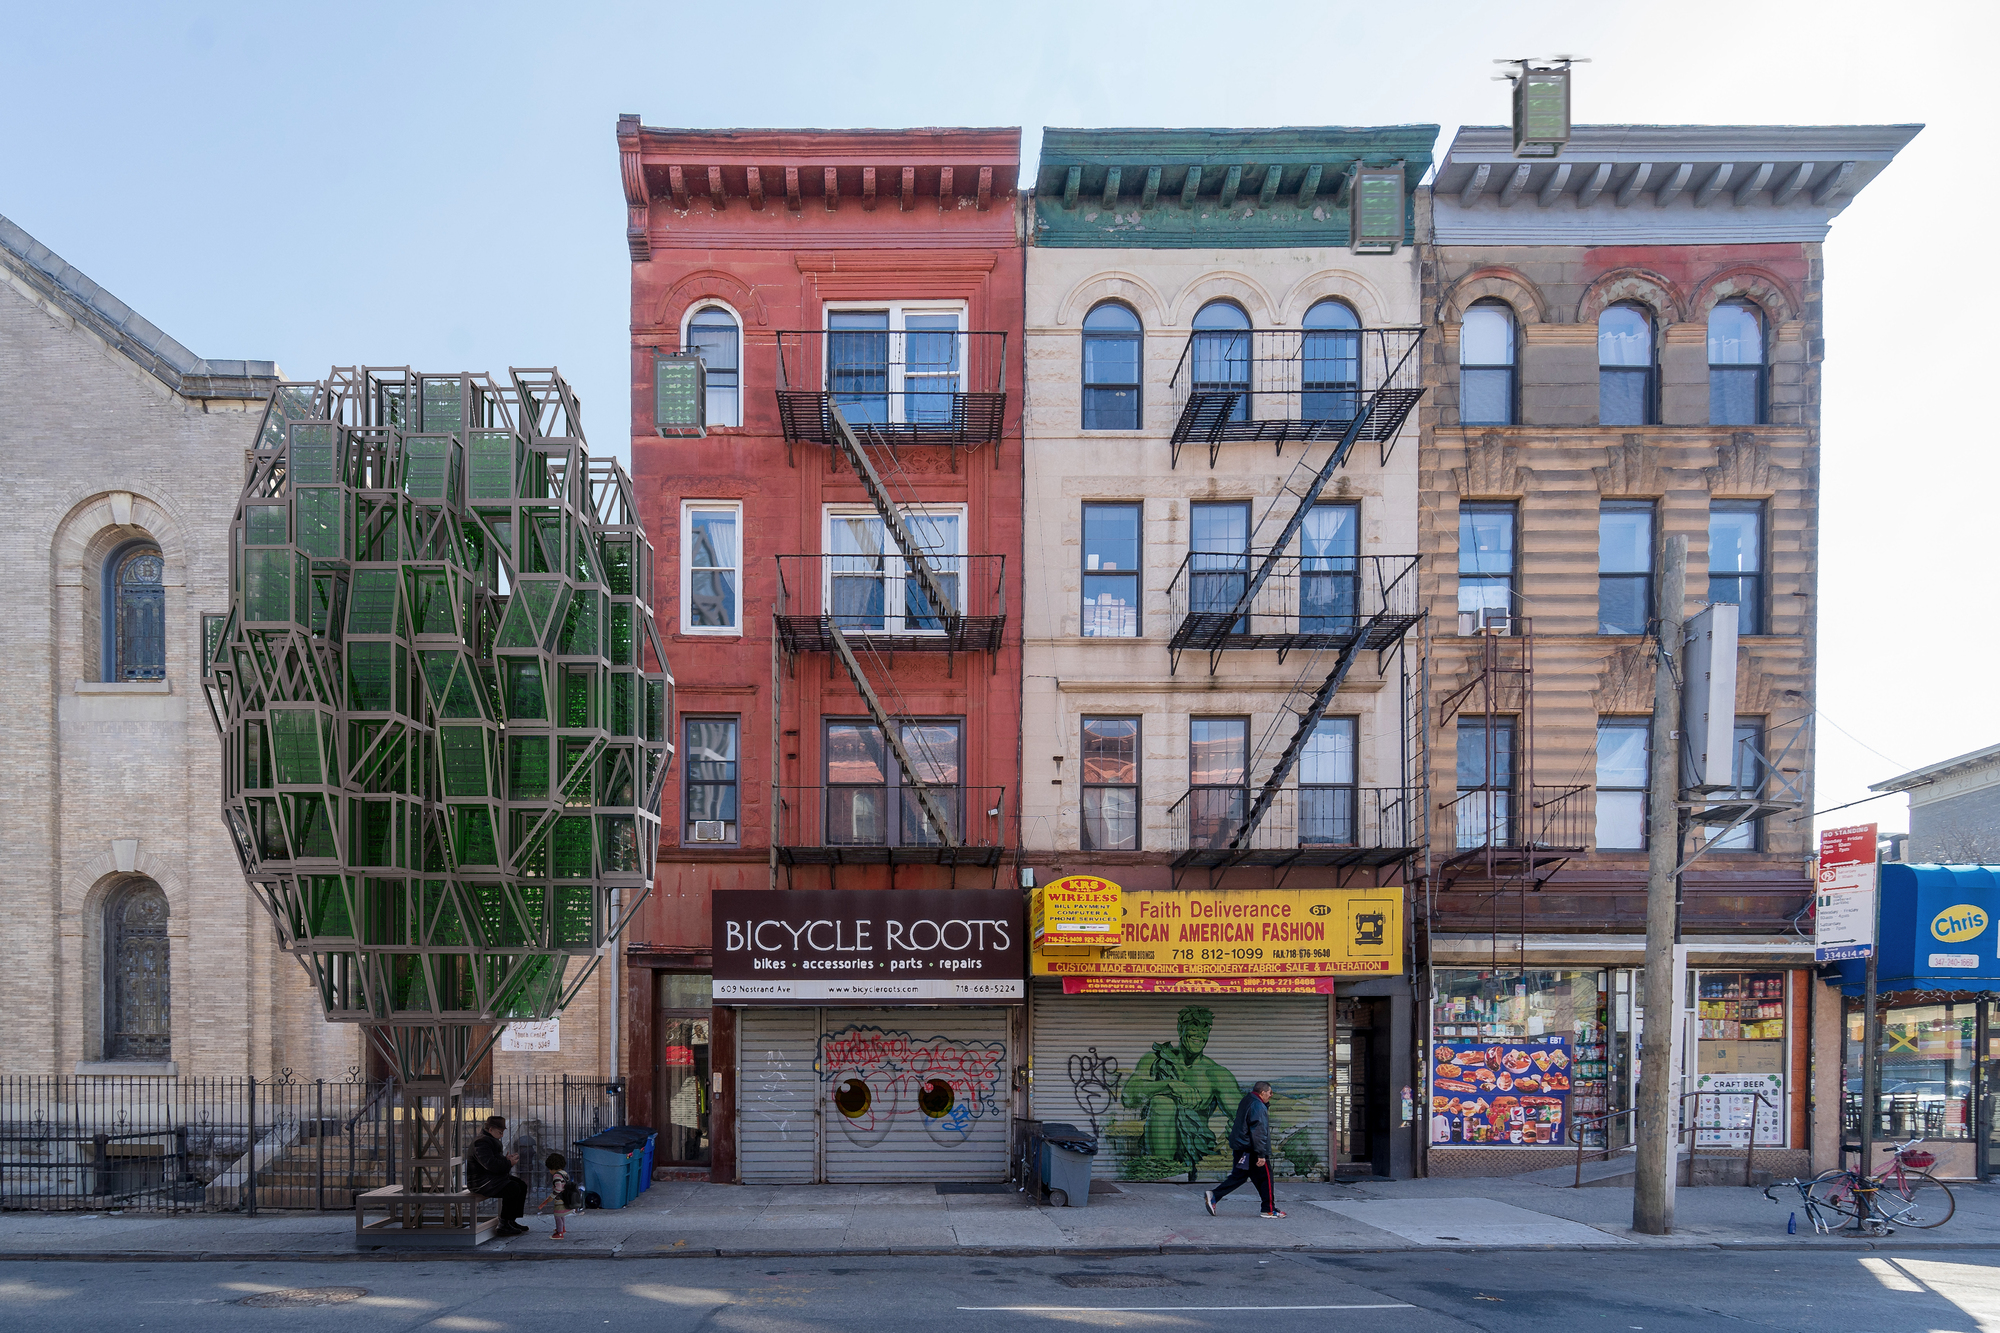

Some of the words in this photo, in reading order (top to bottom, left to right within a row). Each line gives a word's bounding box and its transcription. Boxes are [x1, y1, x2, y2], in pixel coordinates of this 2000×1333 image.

[1835, 827, 1869, 837] STANDING
[1069, 880, 1099, 889] KRS
[1048, 893, 1118, 902] WIRELESS
[1140, 900, 1181, 918] Faith
[1190, 900, 1292, 918] Deliverance
[1312, 905, 1328, 915] 611
[1935, 911, 1984, 937] Chris
[726, 919, 873, 951] BICYCLE
[886, 919, 1011, 951] ROOTS
[1178, 921, 1254, 943] AMERICAN
[1262, 920, 1325, 941] FASHION
[1172, 949, 1194, 960] 718
[1201, 948, 1263, 960] 812-1099
[1824, 951, 1856, 960] 334614
[753, 958, 787, 970] bikes
[802, 957, 874, 970] accessories
[890, 958, 923, 972] parts
[939, 958, 982, 972] repairs
[1056, 963, 1096, 972] CUSTOM
[1100, 963, 1126, 973] MADE
[1131, 963, 1179, 973] TAILORING
[1183, 963, 1244, 973] EMBROIDERY
[1248, 962, 1282, 972] FABRIC
[1286, 962, 1309, 972] SALE
[1314, 962, 1320, 971] &
[1325, 962, 1382, 971] ALTERATION
[720, 985, 737, 994] 609
[739, 985, 774, 994] Nostrand
[777, 985, 792, 994] Ave
[827, 985, 919, 996] www.bicycleroots.com
[955, 984, 1016, 994] 718-668-5224
[1155, 985, 1240, 993] WIRELESS
[531, 1021, 557, 1033] LIFE
[1549, 1036, 1562, 1044] EBT
